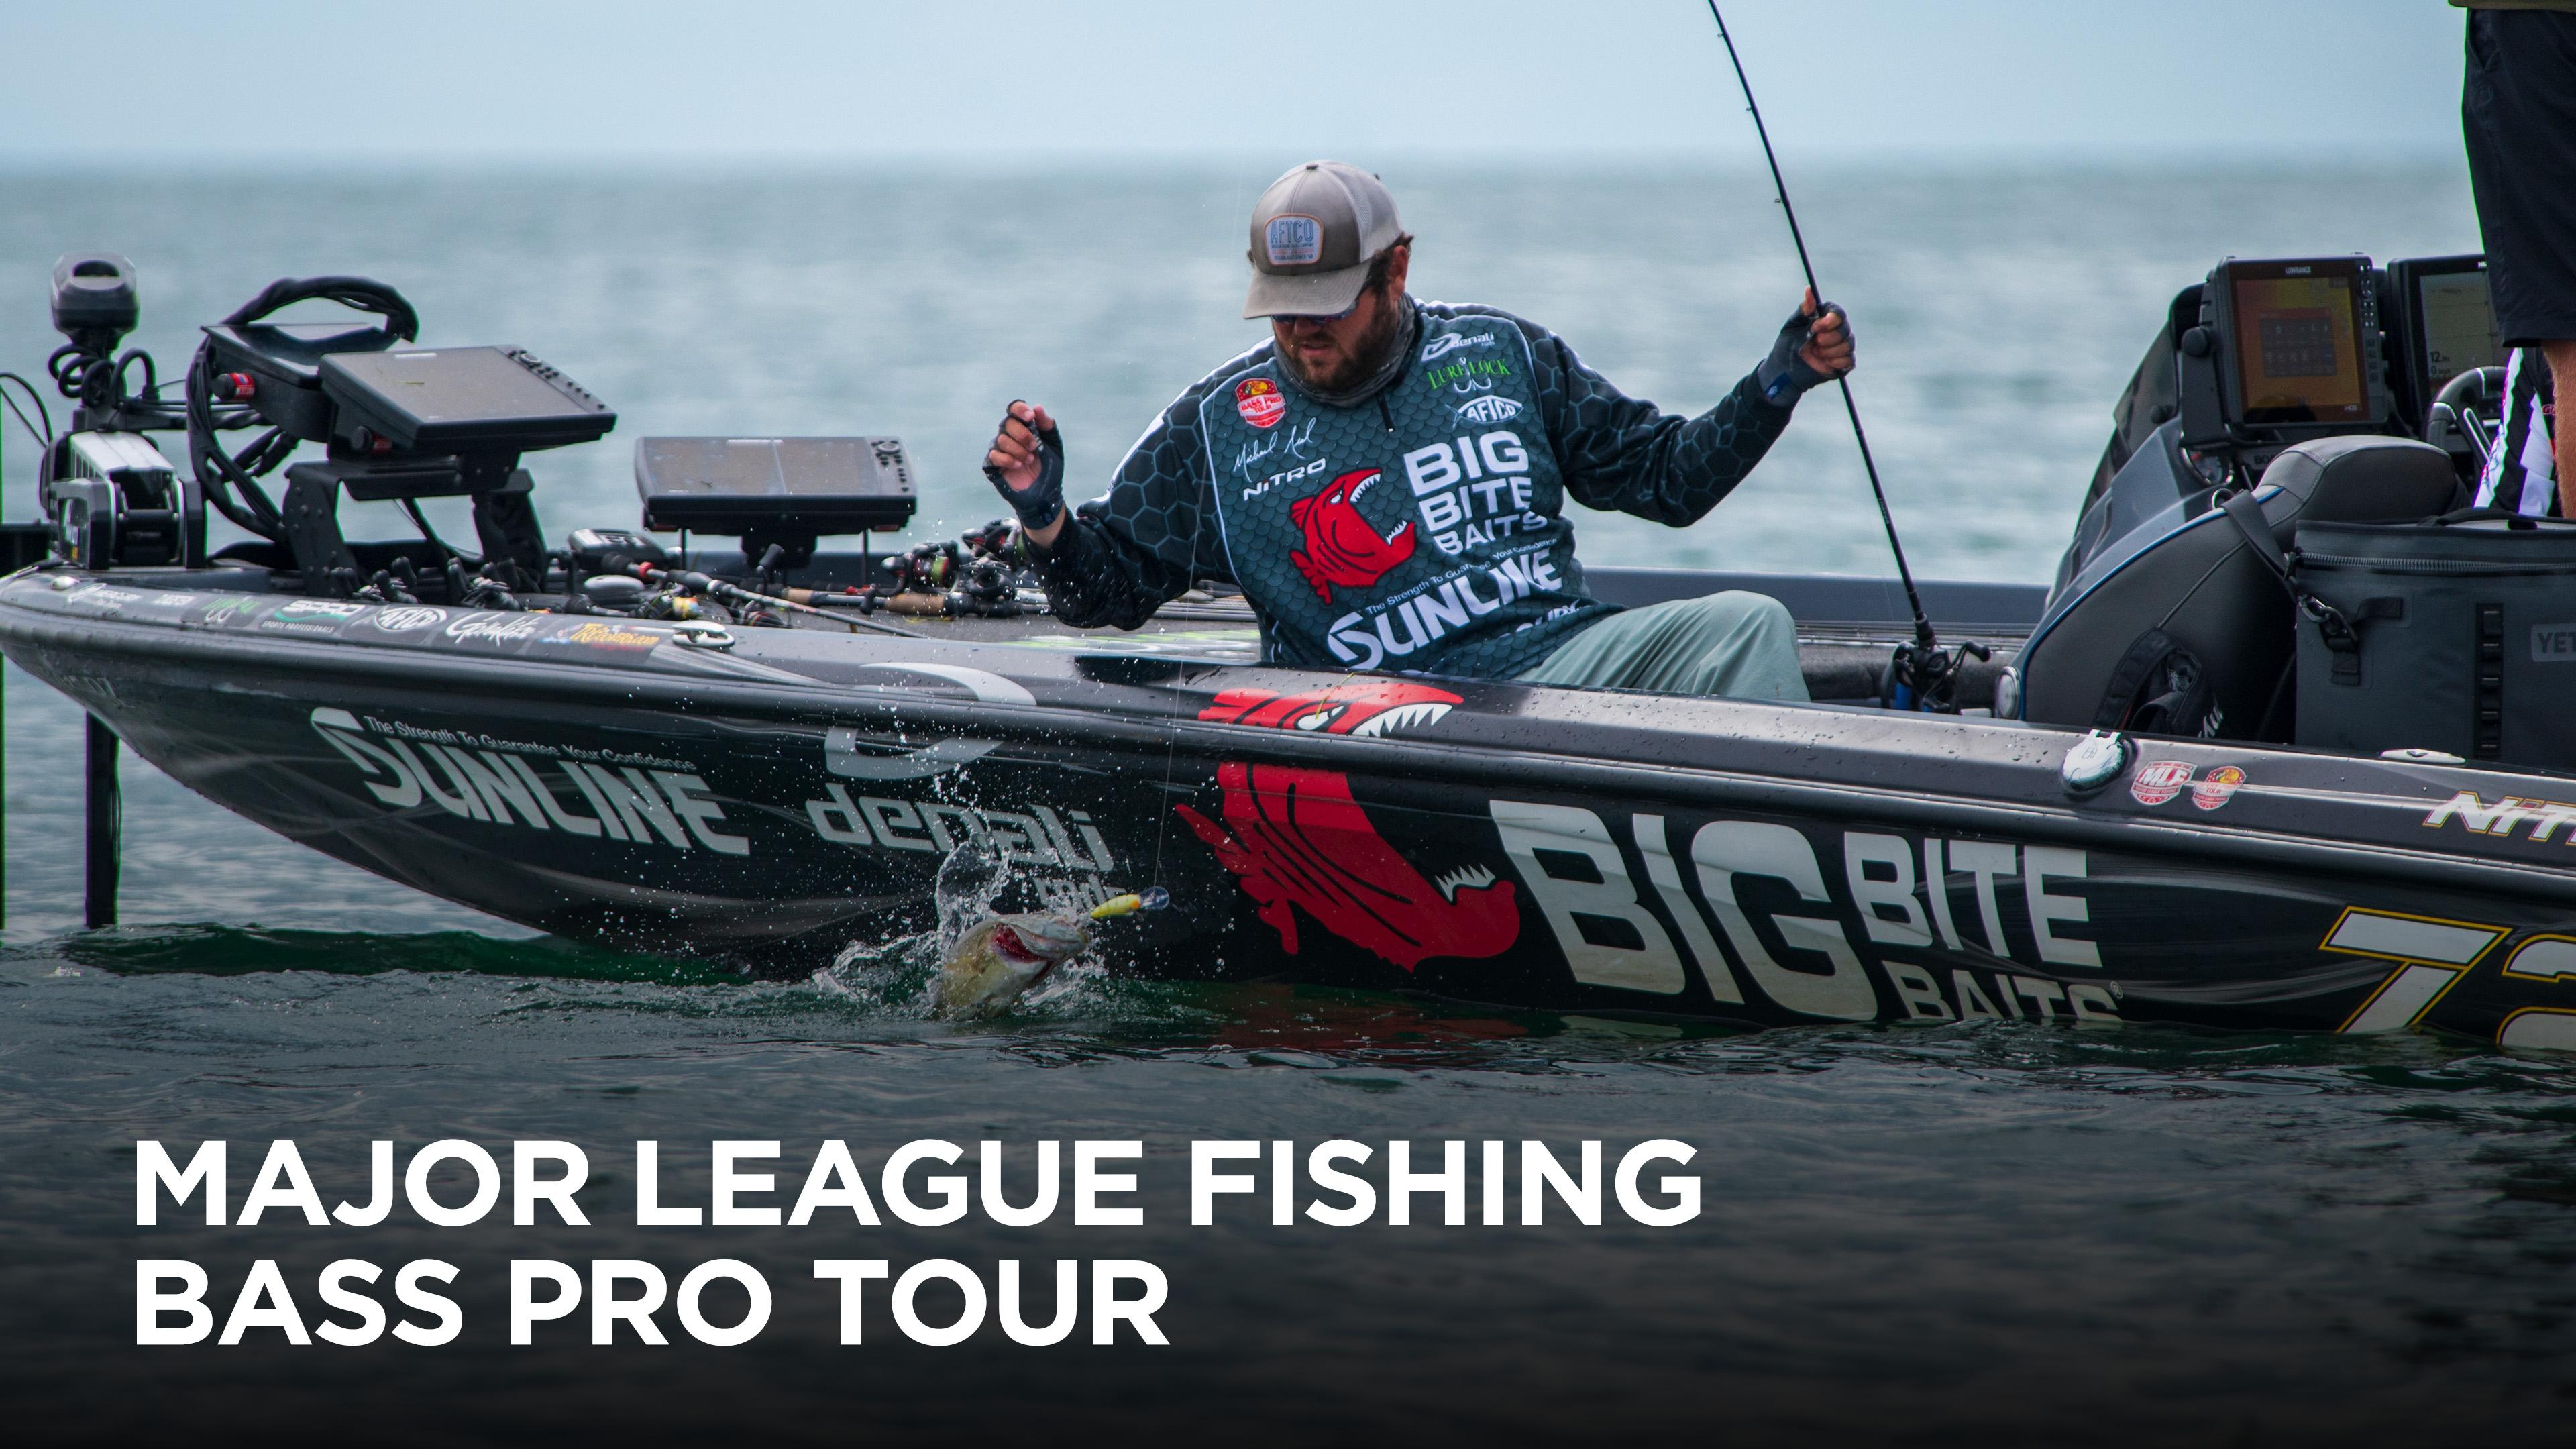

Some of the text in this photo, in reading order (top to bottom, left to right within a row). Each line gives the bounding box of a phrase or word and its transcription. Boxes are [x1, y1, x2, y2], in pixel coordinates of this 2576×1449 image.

[1271, 219, 1313, 243] AFTCO
[2285, 266, 2312, 274] LOWRANCE
[1467, 398, 1516, 421] AFTCO
[1403, 430, 1529, 497] BIG
[1419, 476, 1532, 532] BITE
[1433, 511, 1548, 555] BAITS
[282, 600, 366, 616] SPRO
[1365, 602, 1385, 616] The
[1387, 582, 1430, 606] Strength
[1430, 574, 1443, 586] To
[1492, 546, 1513, 561] Your
[364, 715, 698, 771] The Strength To Guarantee Your Confidence
[310, 706, 751, 855] SUNLINE
[2139, 766, 2189, 788] MLF
[805, 782, 1115, 872] denali
[1489, 799, 1878, 1022] BIG
[1843, 830, 2103, 967] BITE
